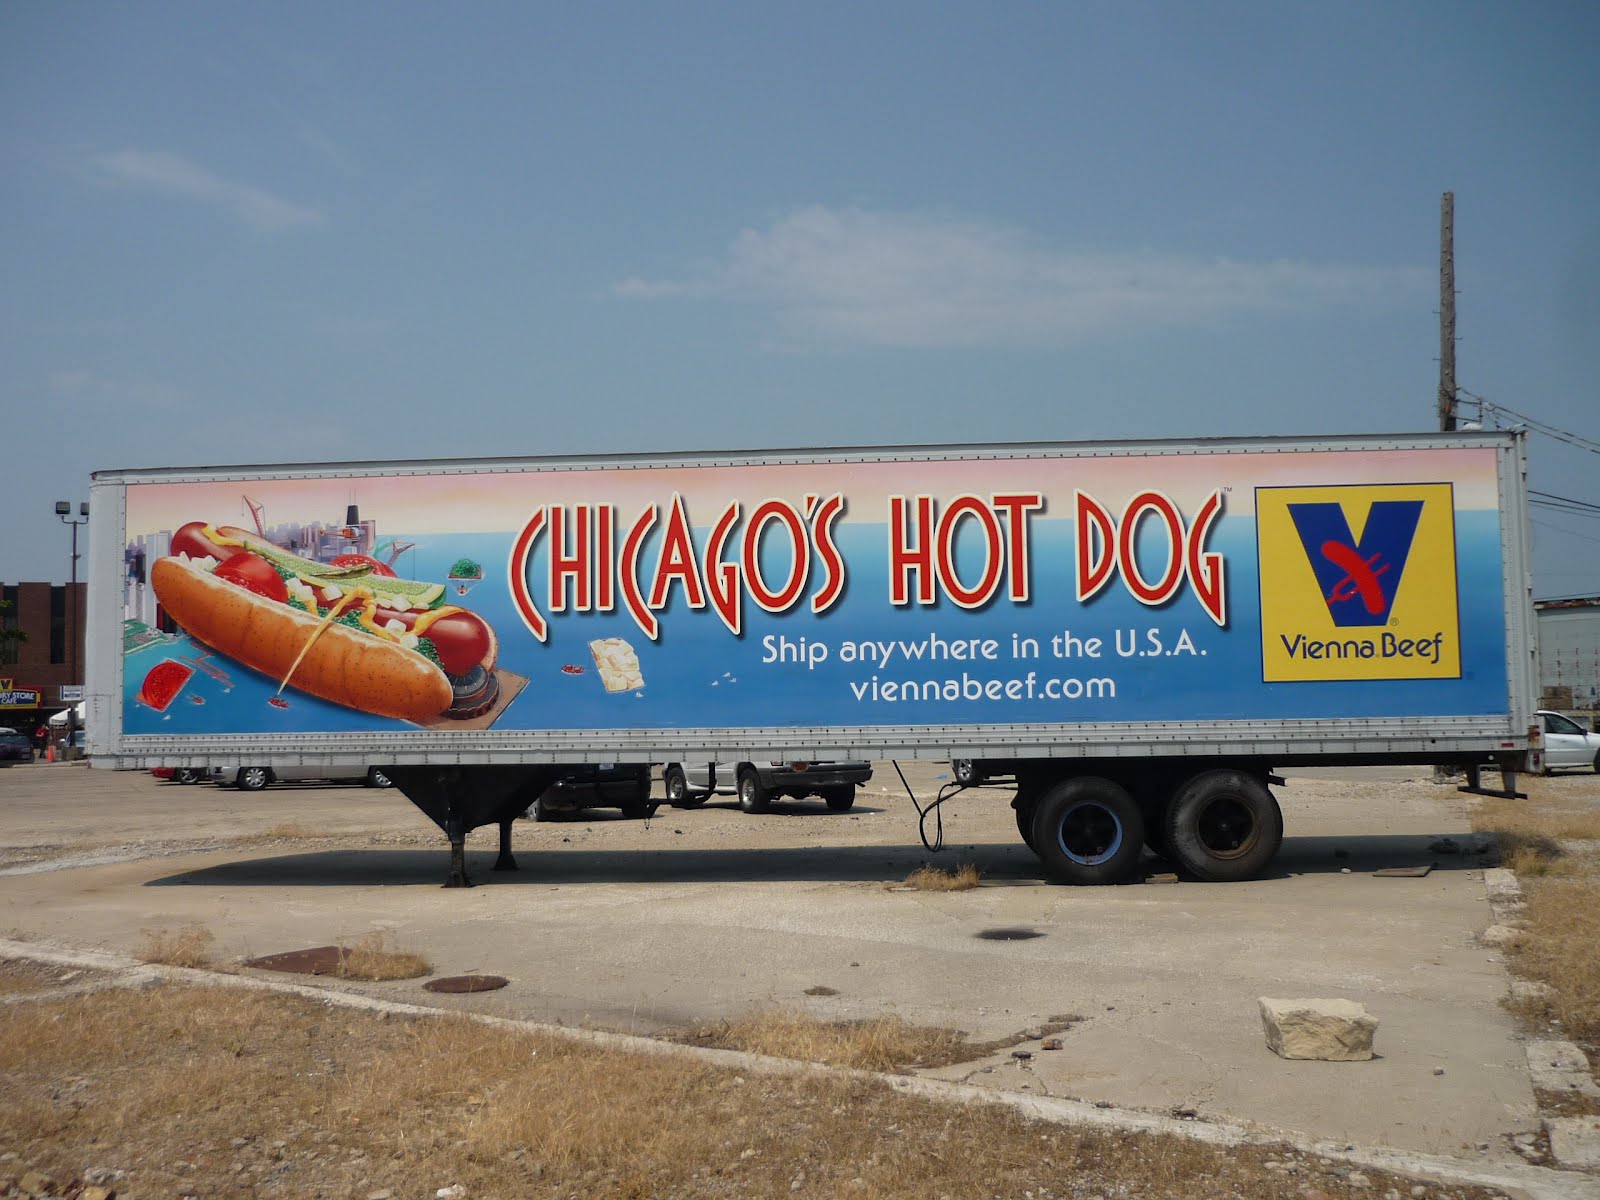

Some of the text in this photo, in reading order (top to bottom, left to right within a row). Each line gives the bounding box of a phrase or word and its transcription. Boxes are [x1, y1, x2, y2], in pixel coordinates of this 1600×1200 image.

[508, 488, 1226, 642] CHICAGO'S HOT DOG
[1286, 500, 1425, 627] V
[762, 628, 1207, 669] Ship anywhere in the U.S.A.
[1280, 631, 1443, 664] Vienna Beef
[850, 672, 1116, 703] viennabeef.com
